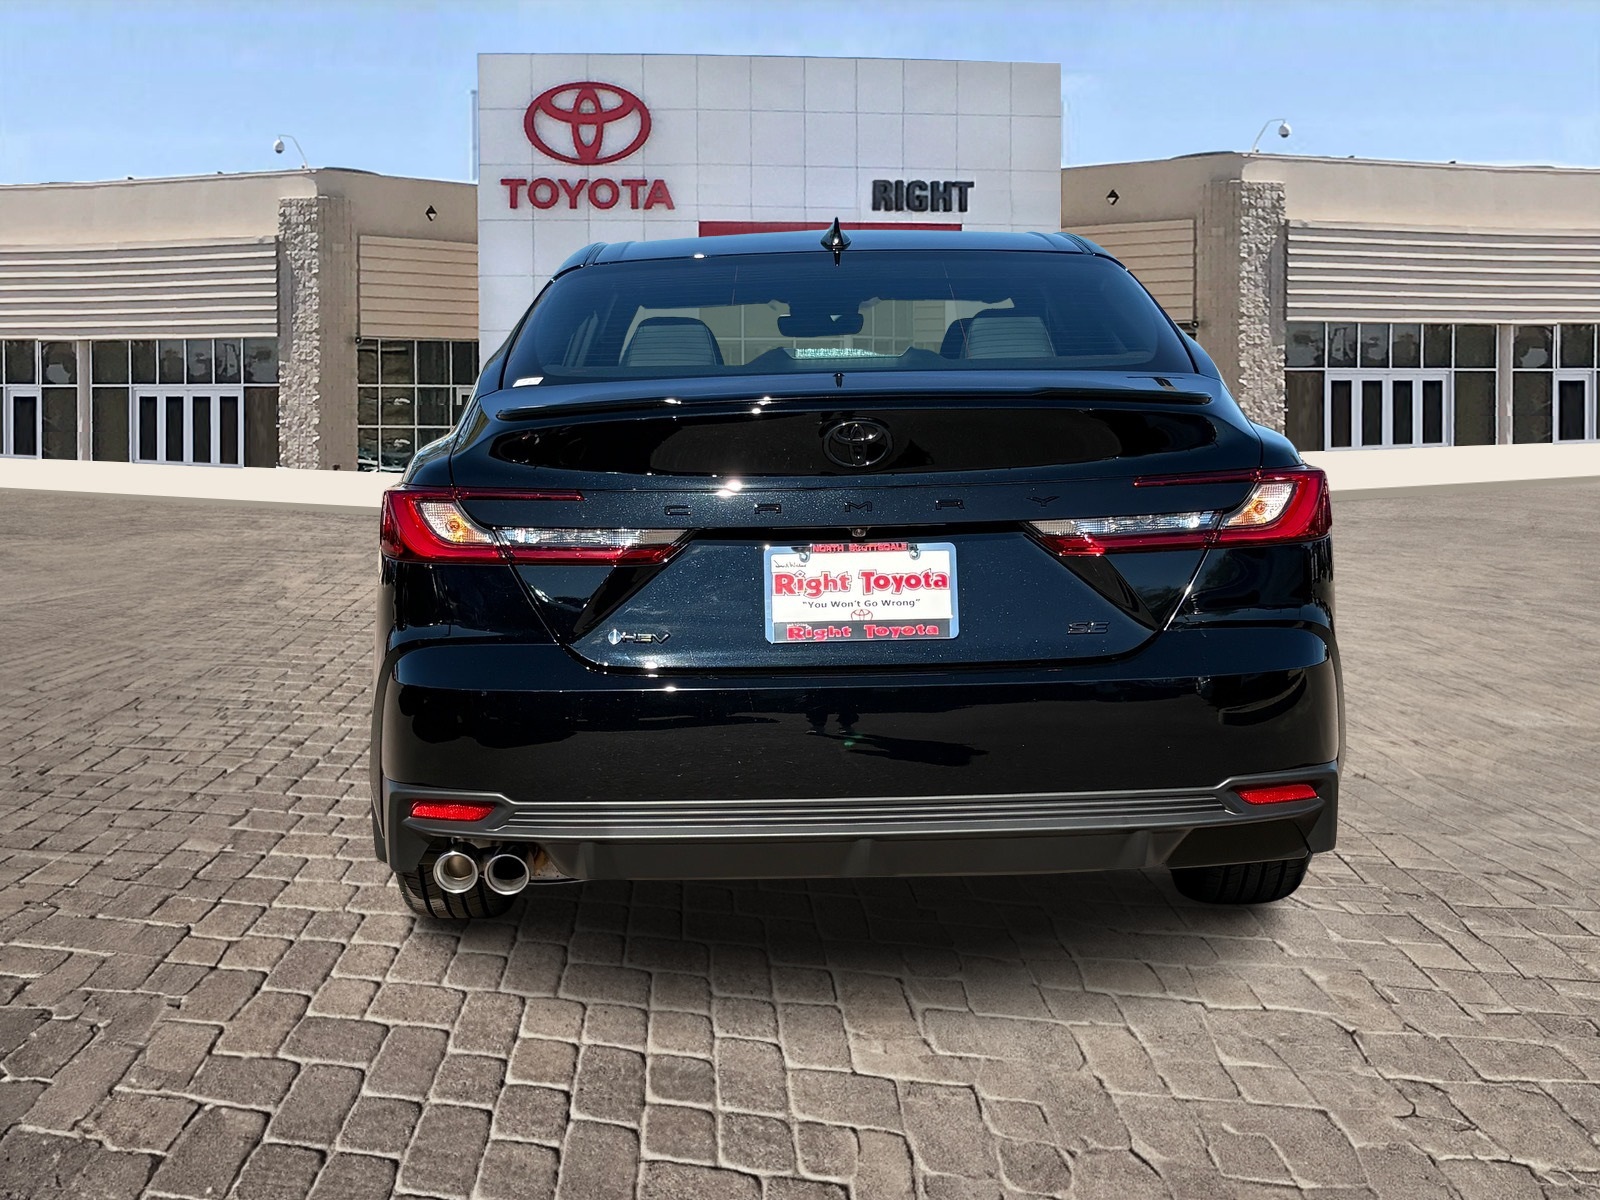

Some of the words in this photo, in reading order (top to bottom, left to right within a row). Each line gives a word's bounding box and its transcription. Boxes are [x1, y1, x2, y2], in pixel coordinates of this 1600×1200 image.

[500, 178, 674, 210] TOYOTA
[871, 179, 975, 213] RIGHT
[664, 495, 1060, 516] CAMRY
[812, 543, 844, 552] NORTH
[772, 570, 852, 598] Right
[858, 568, 950, 595] Toyota
[830, 599, 861, 608] Won't
[864, 599, 878, 608] Go
[786, 625, 852, 641] Right
[863, 624, 939, 638] Toyota
[1067, 621, 1110, 635] SE
